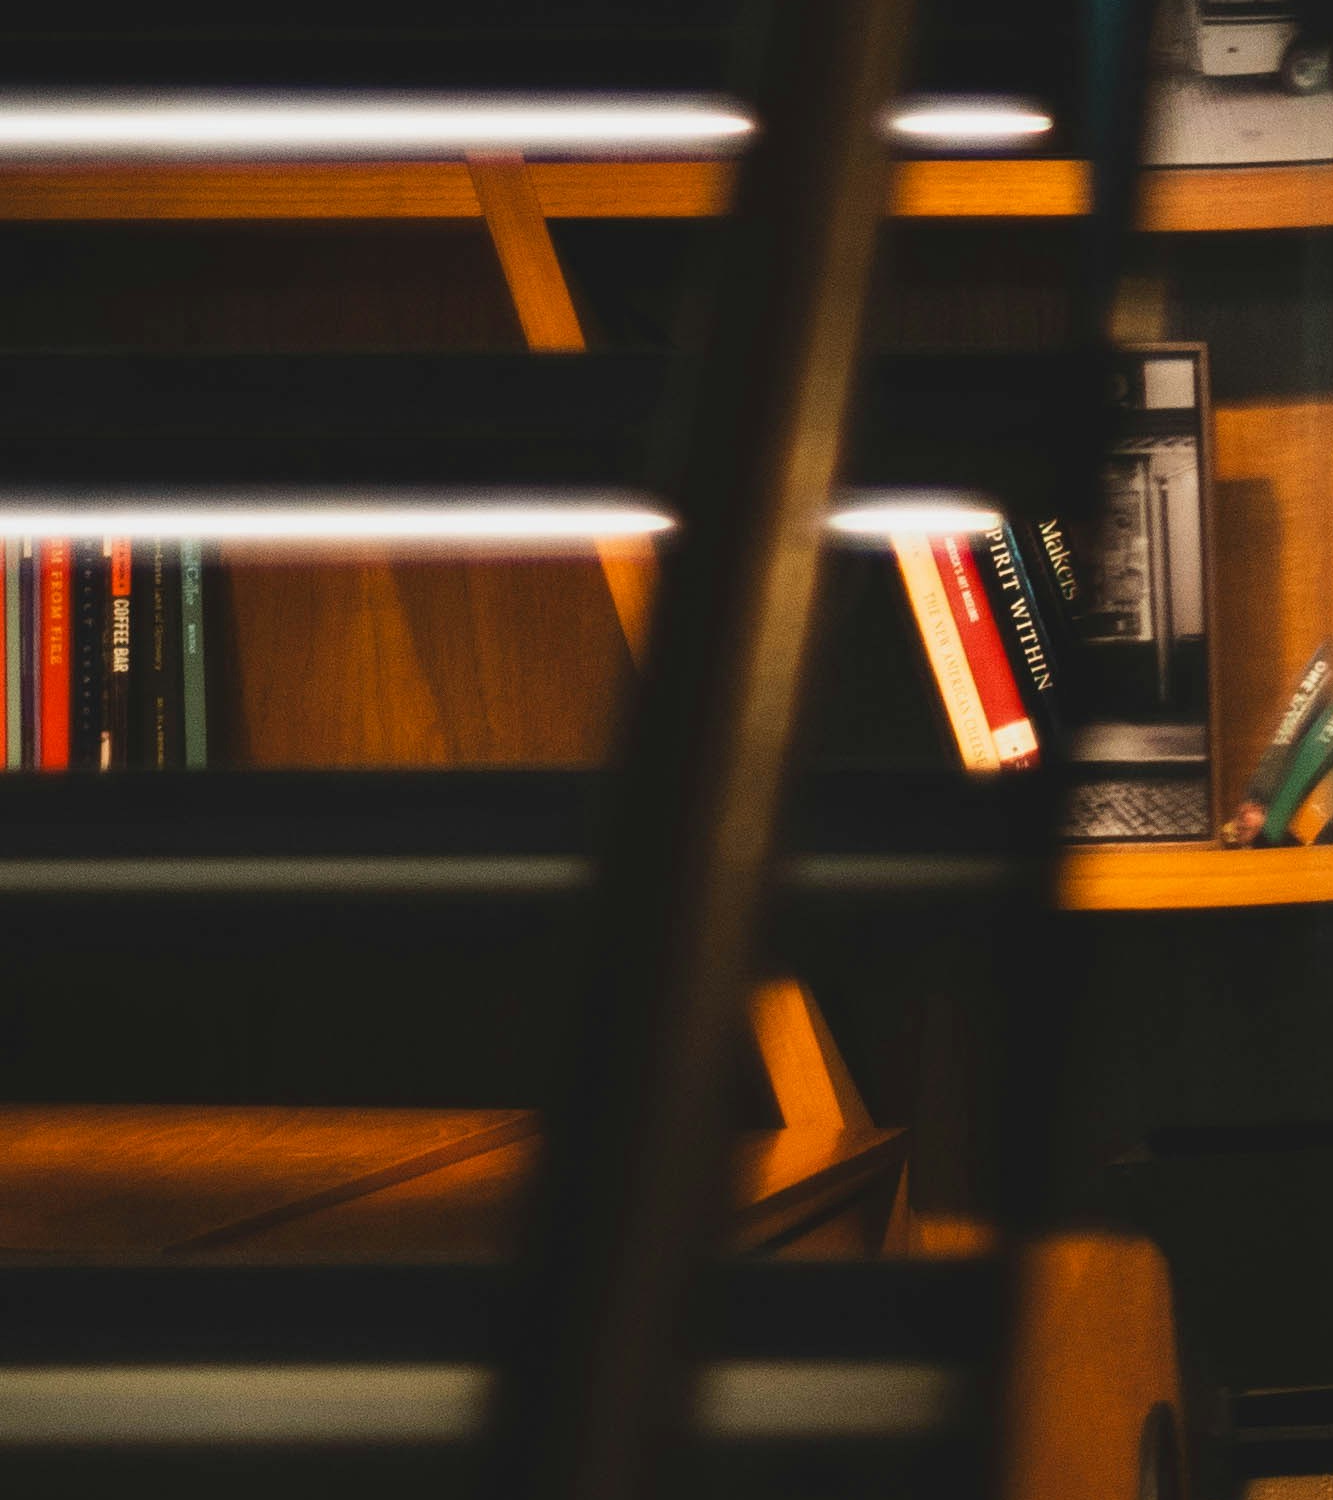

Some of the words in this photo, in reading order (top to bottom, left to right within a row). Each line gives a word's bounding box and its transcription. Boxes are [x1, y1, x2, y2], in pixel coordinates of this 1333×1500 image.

[1037, 517, 1086, 602] Makers
[113, 598, 130, 645] COFFEE
[984, 526, 1020, 593] PIRIT
[1007, 596, 1053, 691] WITHIN
[112, 647, 129, 673] BAR
